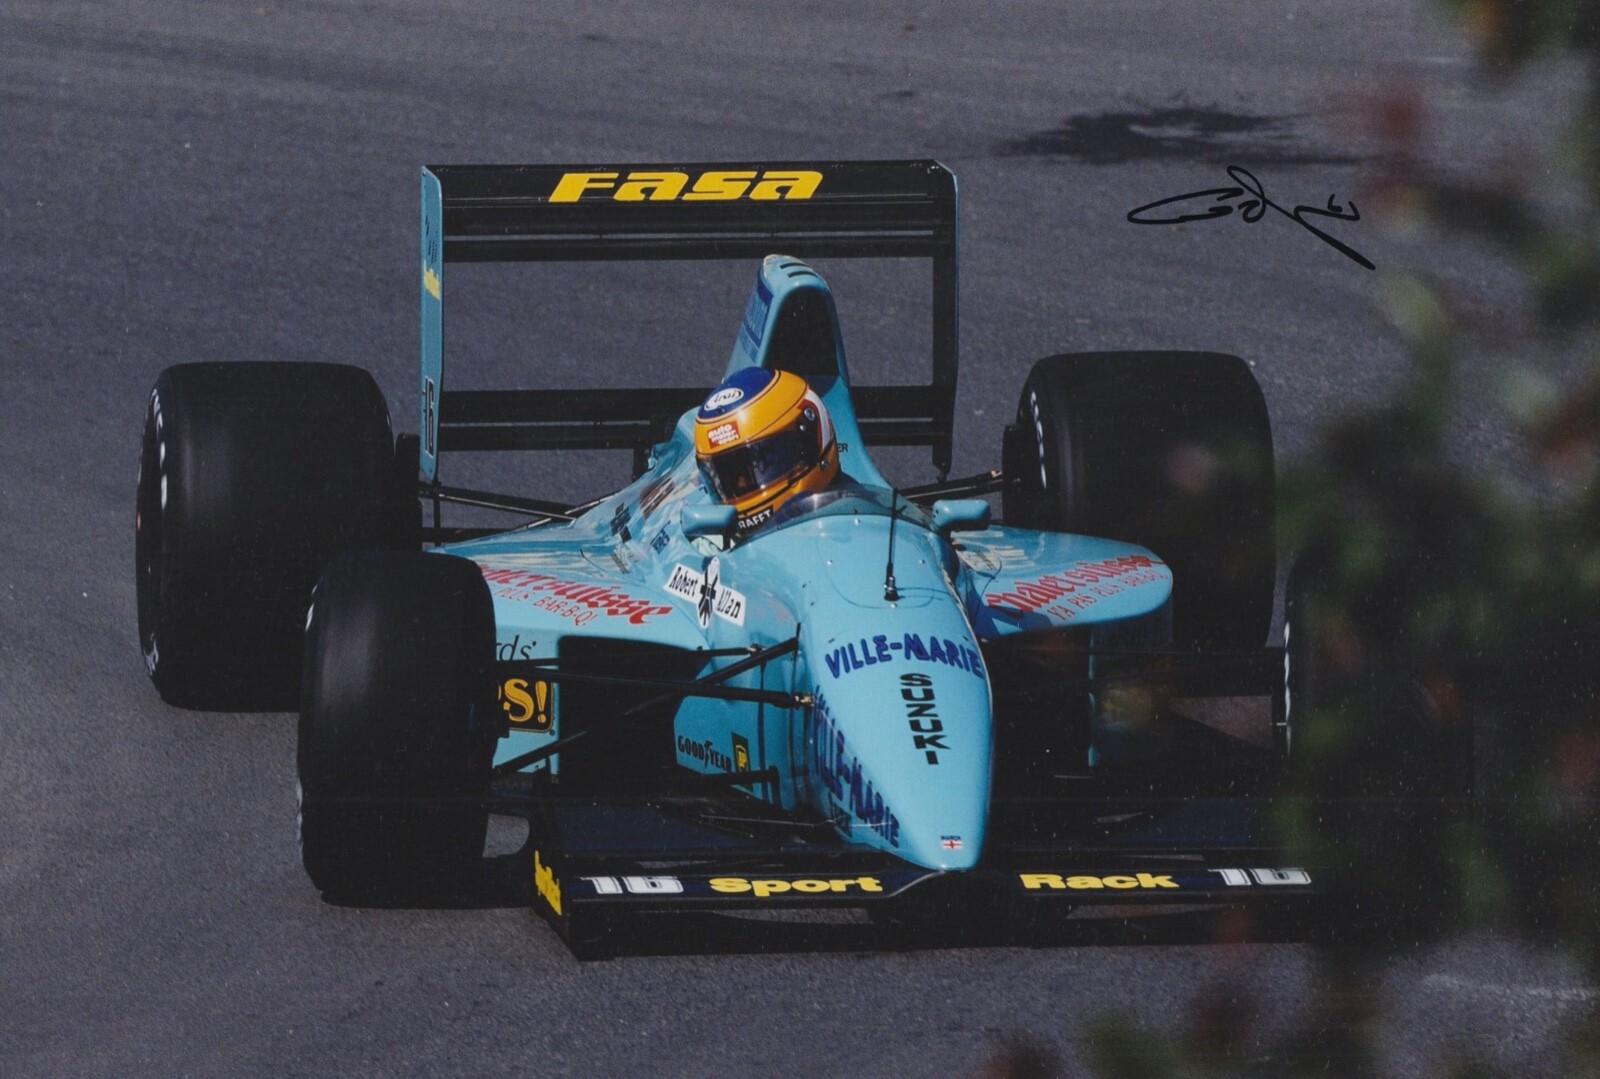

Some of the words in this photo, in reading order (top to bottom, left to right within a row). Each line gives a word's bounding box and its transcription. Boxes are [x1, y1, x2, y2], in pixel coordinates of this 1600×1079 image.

[825, 633, 985, 679] VILLE-MARIE
[498, 678, 548, 723] S!
[900, 673, 950, 765] SUZUKI
[677, 735, 732, 773] GOODYEAR
[580, 876, 684, 894] 16
[709, 877, 883, 896] Sport
[1019, 873, 1179, 889] Rack
